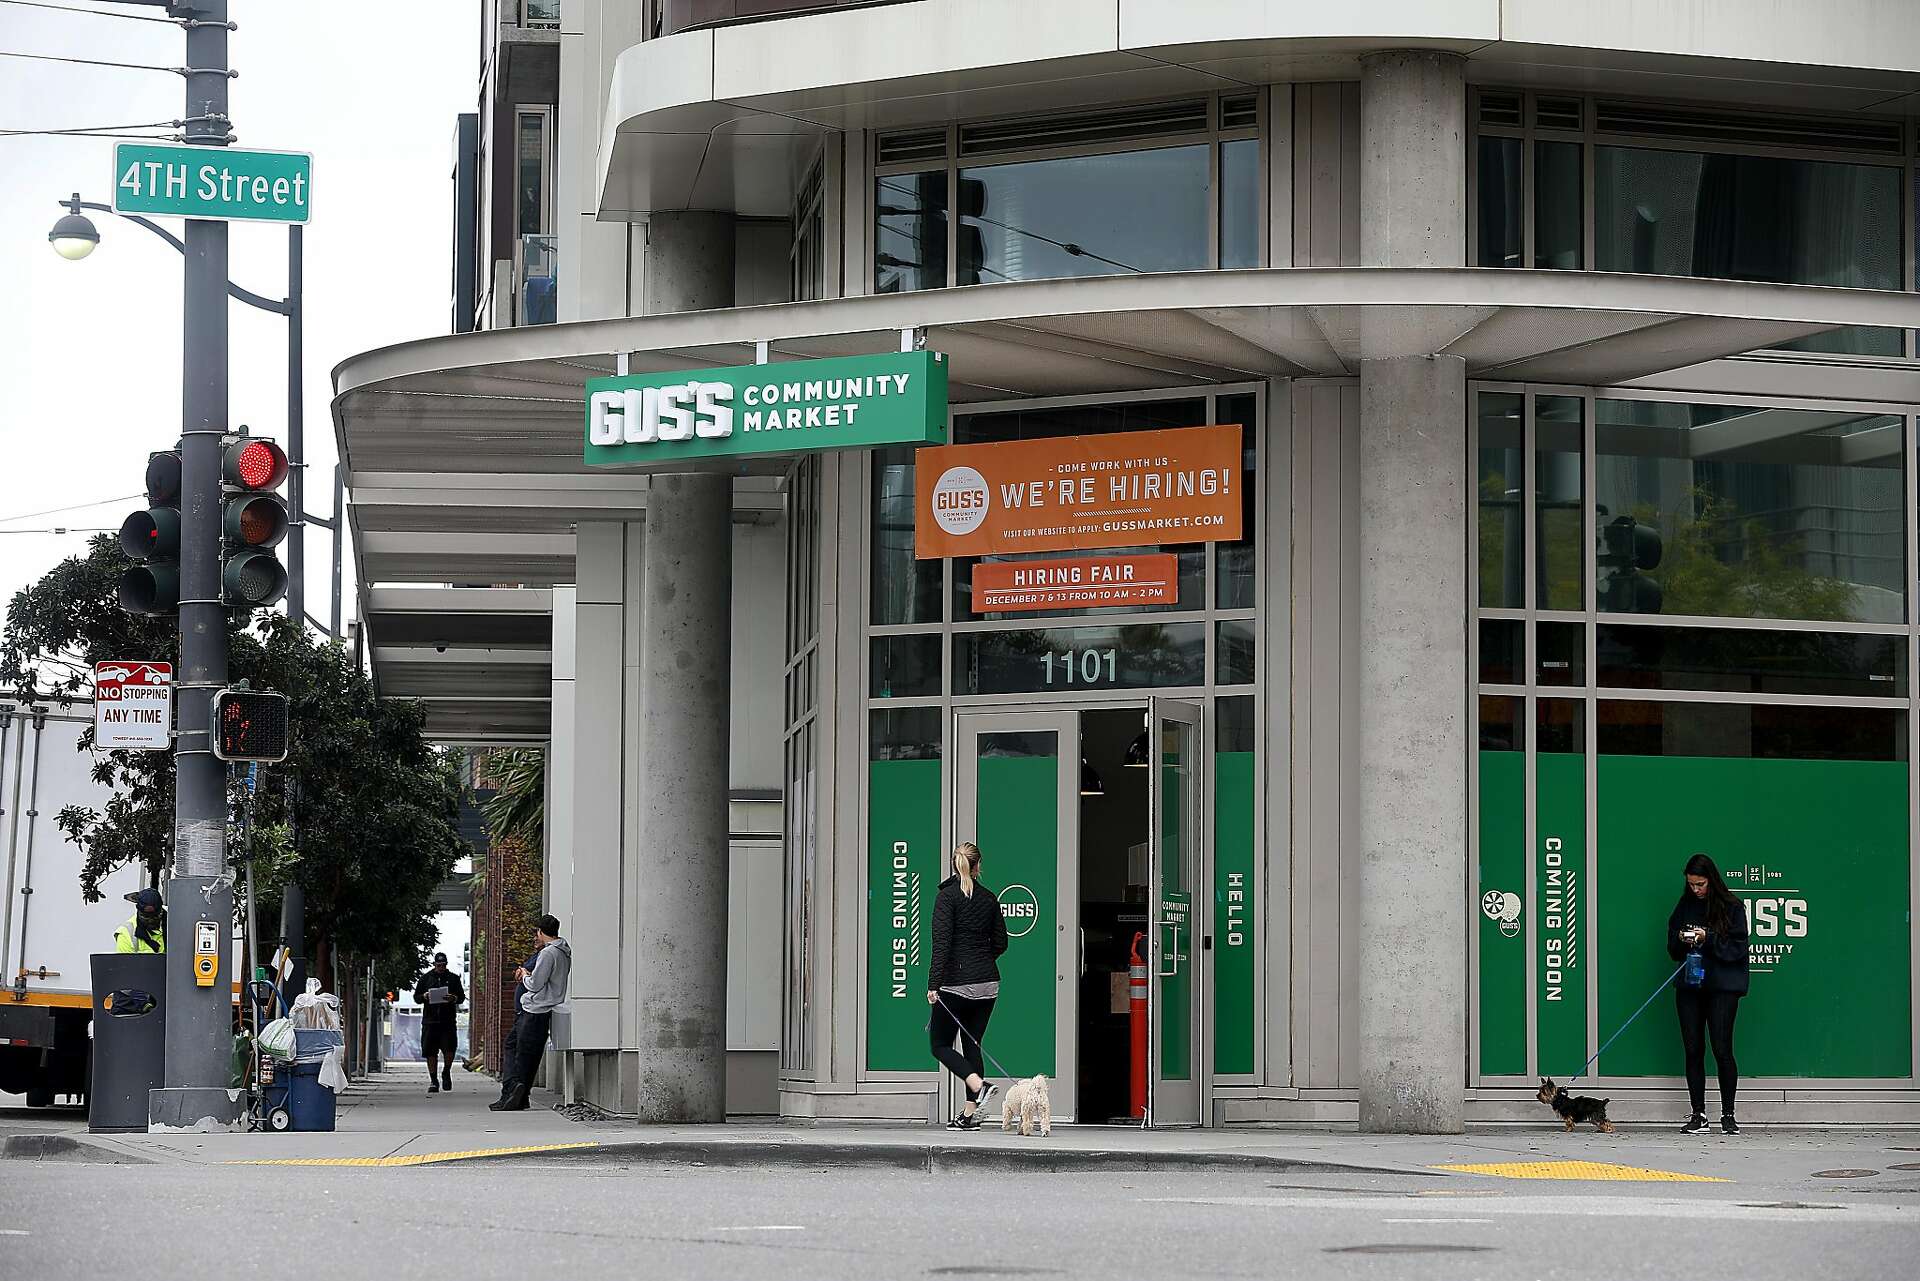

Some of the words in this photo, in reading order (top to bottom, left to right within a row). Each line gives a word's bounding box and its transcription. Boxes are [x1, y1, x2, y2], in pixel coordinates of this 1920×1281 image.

[119, 161, 188, 199] 4TH
[197, 165, 306, 206] Street
[589, 380, 734, 446] GUS'S
[743, 374, 911, 406] COMMUNITY
[743, 403, 859, 432] MARKET
[1057, 463, 1087, 473] COME
[1090, 460, 1121, 471] WORK
[1124, 458, 1150, 469] WITH
[1155, 457, 1169, 466] US
[937, 490, 984, 510] GUS'S
[1000, 477, 1096, 509] WE'RE
[1110, 468, 1230, 502] HIRING!
[1003, 529, 1022, 539] VISIT
[1023, 528, 1036, 537] OUR
[1037, 526, 1067, 536] WEBSITE
[1067, 526, 1076, 534] TO
[1077, 524, 1102, 534] APPLY:
[1103, 515, 1224, 532] GUSSMARKET.COM
[1014, 567, 1082, 586] HIRING
[1090, 564, 1135, 582] FAIR
[985, 594, 1037, 605] DECEMBER
[1040, 594, 1045, 602] 7
[1047, 593, 1054, 602] &
[1056, 593, 1067, 601] 13
[1069, 591, 1097, 601] FROM
[1100, 590, 1111, 599] 10
[1113, 590, 1129, 598] AM
[1140, 589, 1146, 597] 2
[1148, 588, 1163, 597] PM
[1040, 648, 1116, 684] 1101
[98, 686, 120, 699] NO
[123, 687, 168, 700] STOPPING
[104, 708, 129, 724] ANY
[133, 709, 162, 724] TIME
[893, 841, 908, 929] COMING
[1545, 837, 1562, 929] COMING
[1000, 903, 1034, 917] GUS'S
[1228, 873, 1243, 946] HELLO
[1748, 944, 1793, 954] UNITY
[1748, 955, 1781, 964] RKET
[892, 938, 907, 998] SOON
[1546, 939, 1562, 1001] SOON
